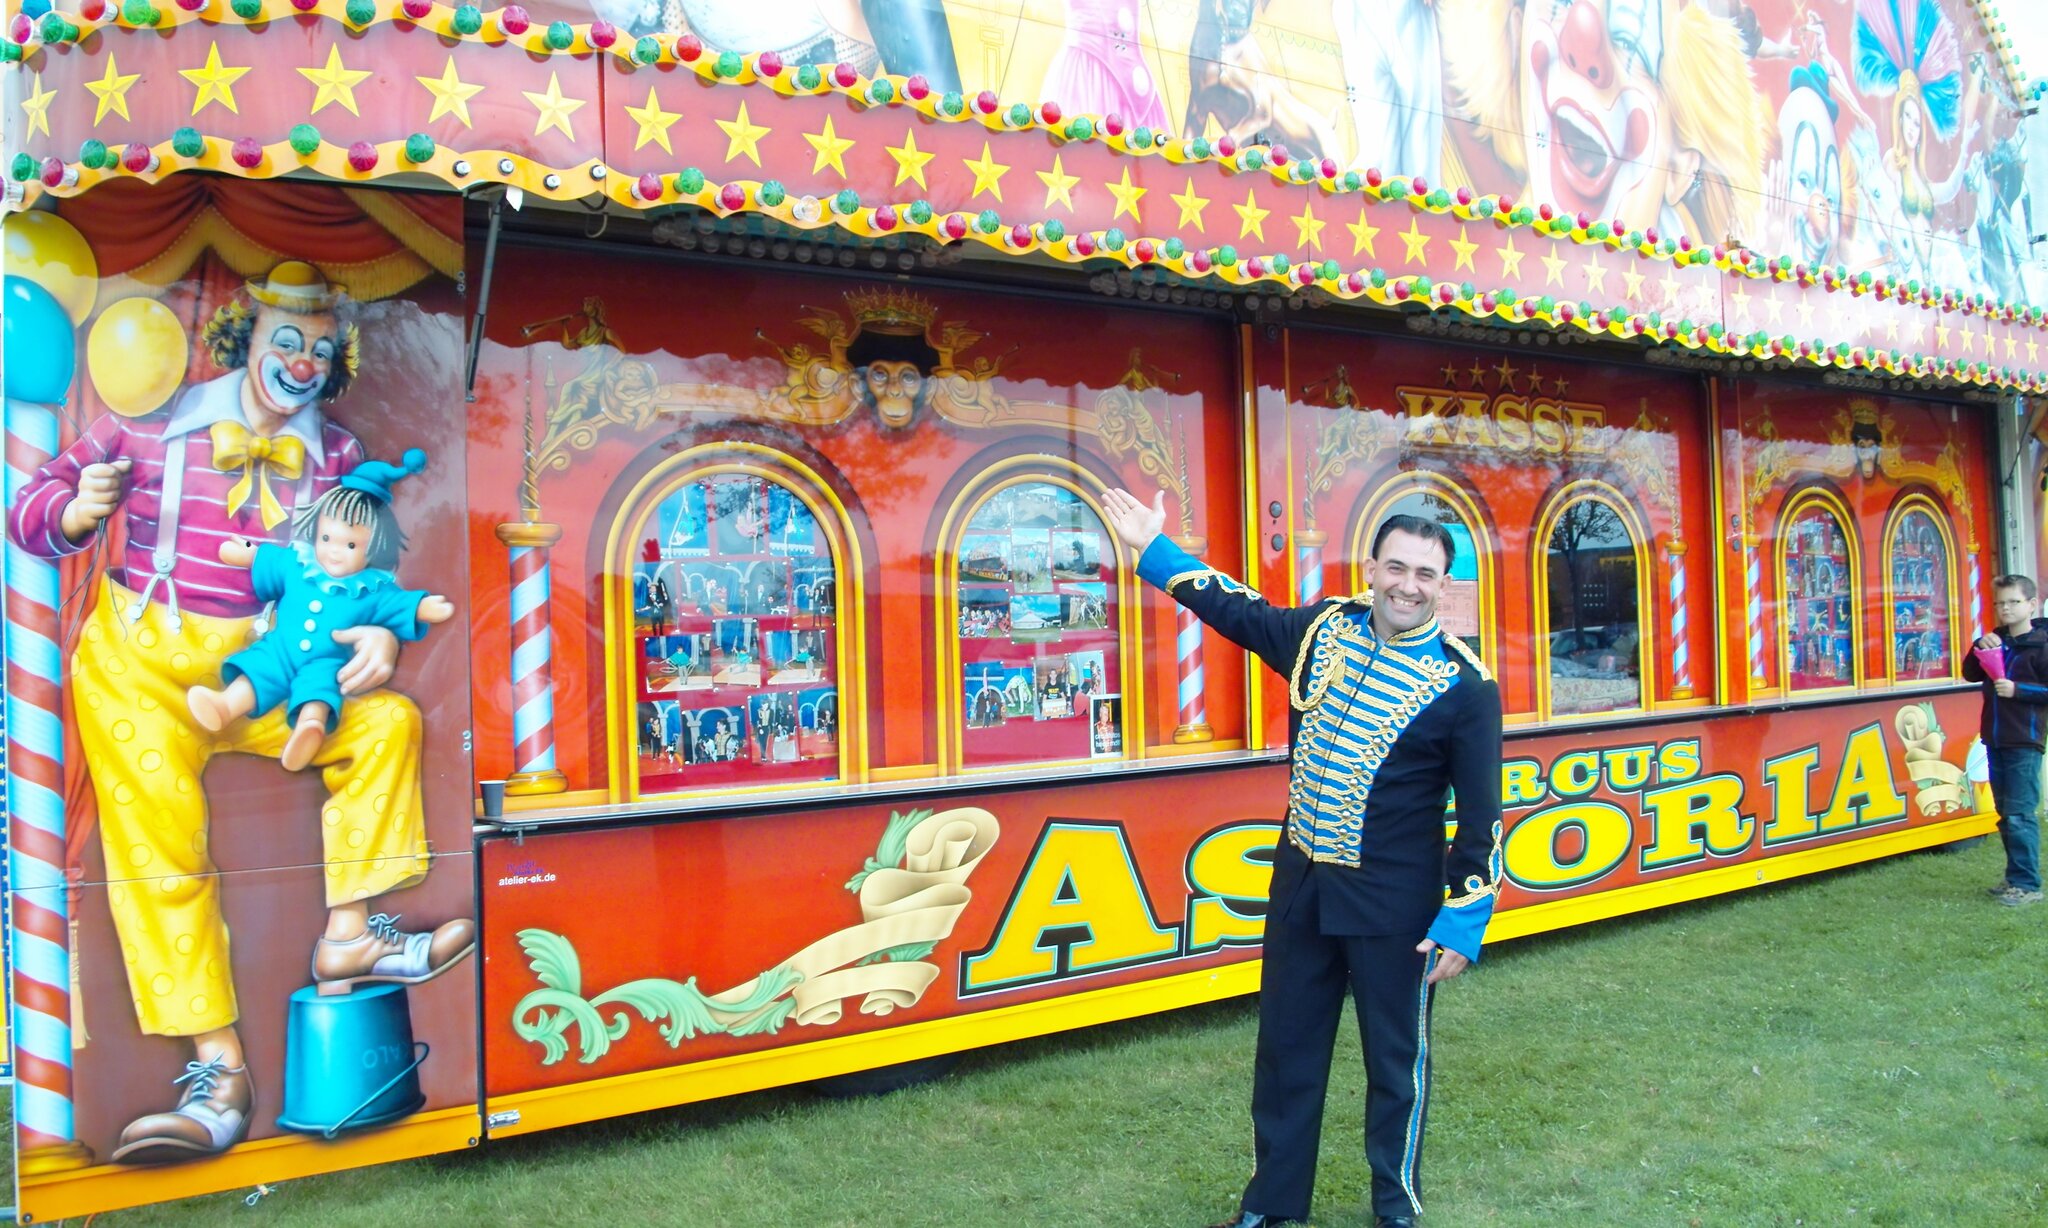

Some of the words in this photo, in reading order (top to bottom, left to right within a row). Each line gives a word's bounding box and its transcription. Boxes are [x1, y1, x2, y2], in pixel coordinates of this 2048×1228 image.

[1398, 390, 1606, 457] KASSE
[498, 872, 556, 886] atelier-ek.de
[957, 719, 1909, 1000] ASORIA
